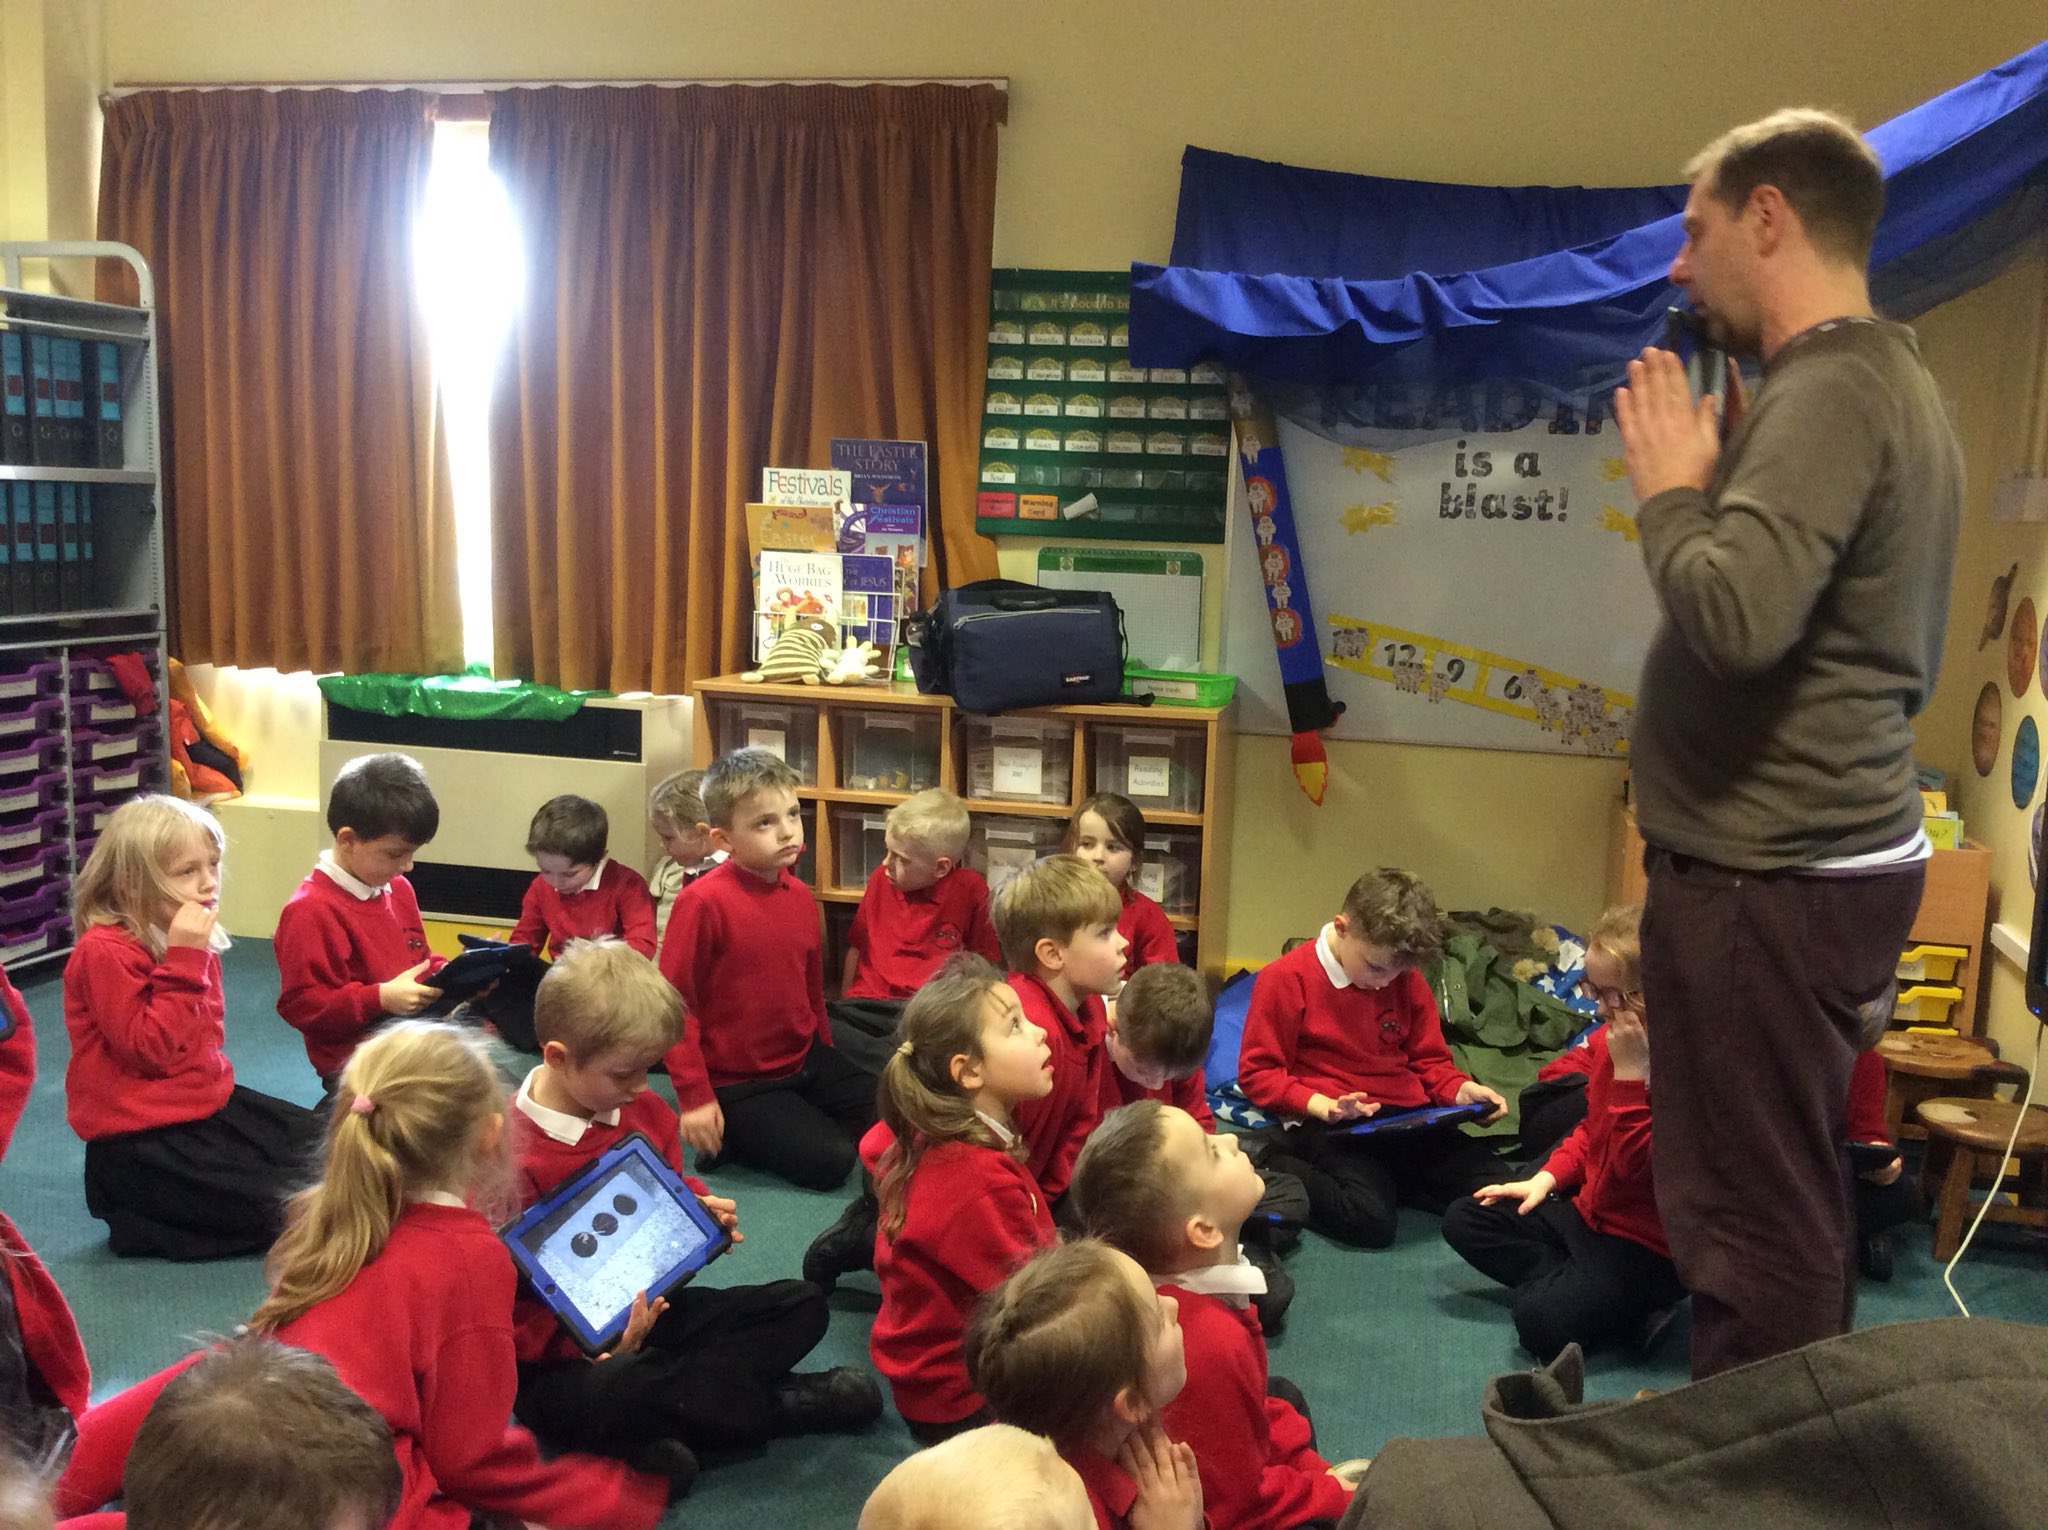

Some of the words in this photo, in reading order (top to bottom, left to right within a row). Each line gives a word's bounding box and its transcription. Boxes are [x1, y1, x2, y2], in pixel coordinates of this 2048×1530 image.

[869, 445, 918, 459] EASTER
[1455, 440, 1493, 478] is
[1514, 452, 1541, 478] a
[855, 459, 898, 472] STORY
[768, 471, 843, 496] Festivals
[1439, 482, 1569, 522] blast!
[870, 506, 916, 515] Christian
[867, 513, 914, 524] Festivals
[806, 562, 831, 576] BAG
[775, 573, 832, 587] WORRIES
[861, 576, 887, 588] JESUS
[1446, 658, 1466, 683] 9
[1503, 675, 1523, 700] 6
